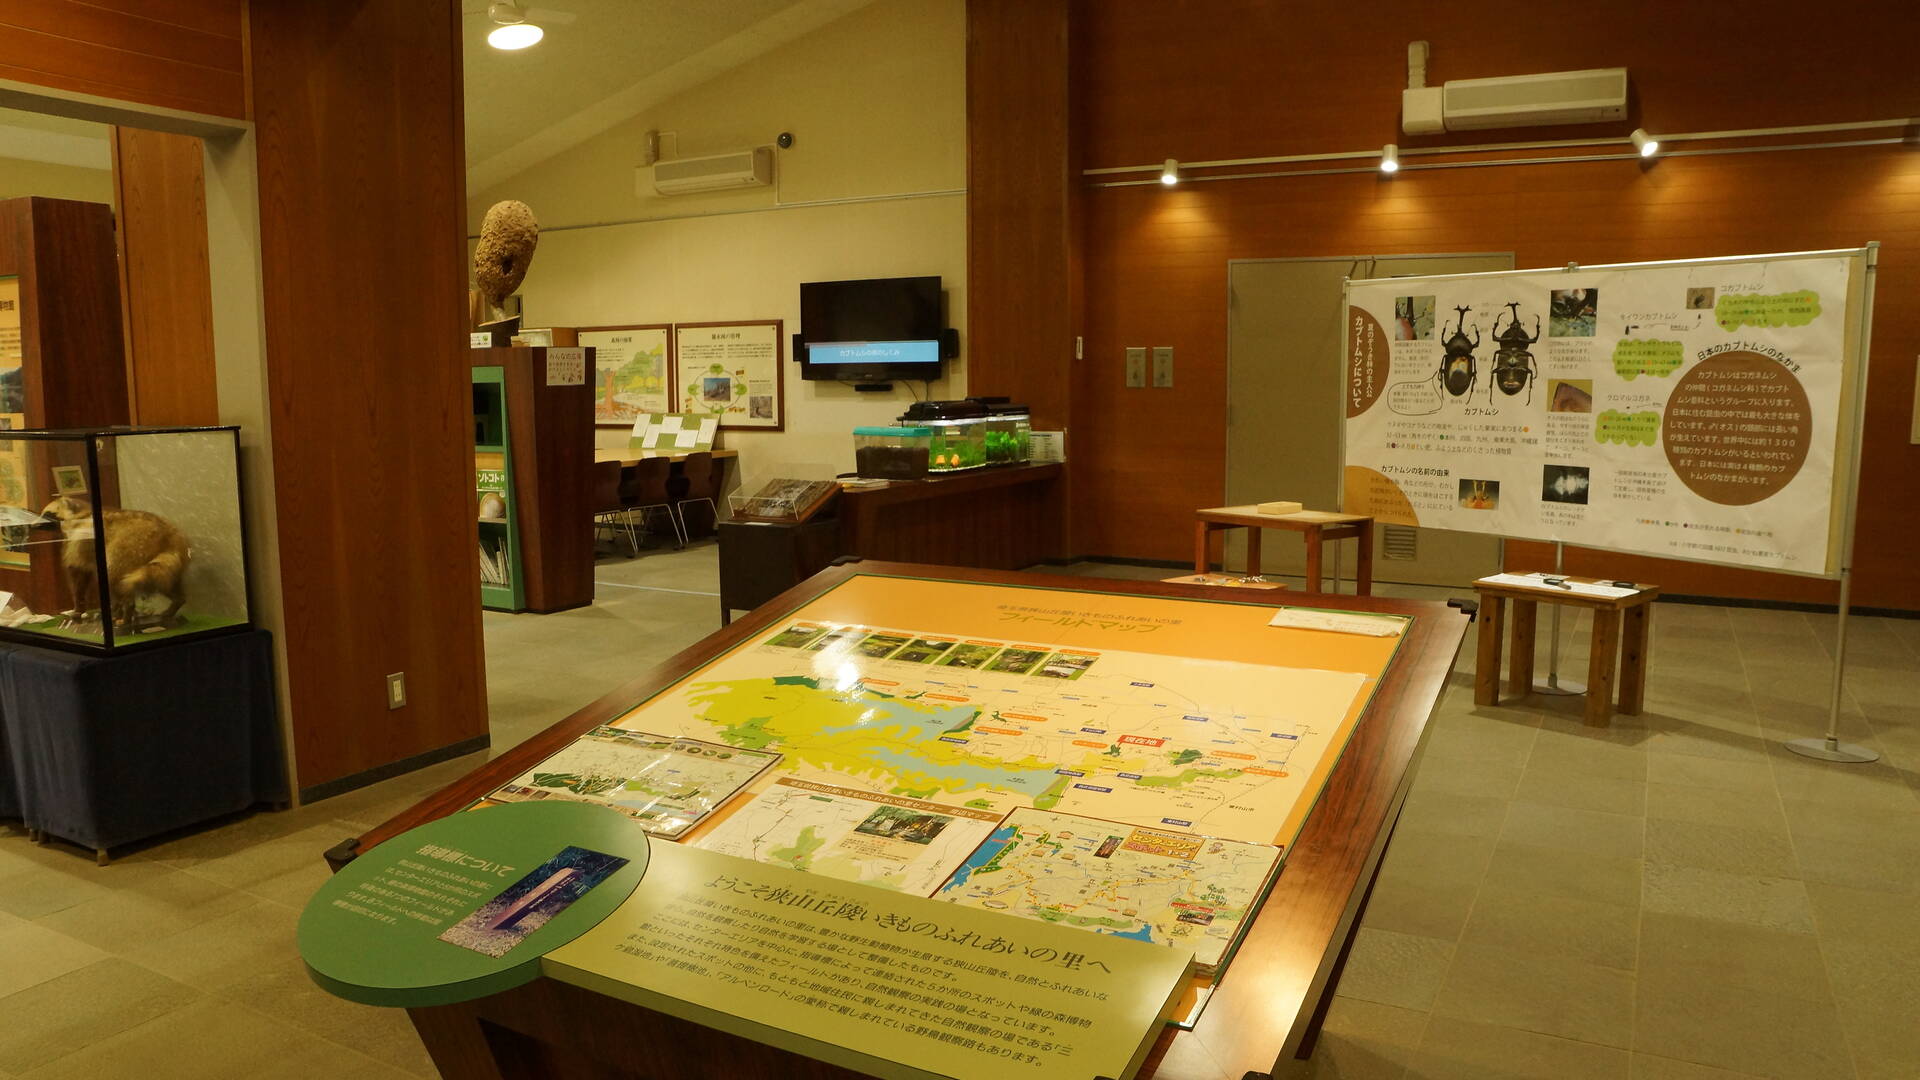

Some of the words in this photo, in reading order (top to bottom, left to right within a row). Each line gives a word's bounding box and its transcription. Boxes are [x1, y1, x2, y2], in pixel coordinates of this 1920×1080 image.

[1352, 315, 1363, 408] カブトムシについて
[1697, 341, 1802, 375] 日本のカブトムシのなかま
[1464, 407, 1500, 417] カブトムシ
[479, 473, 500, 484] ソトコト
[1381, 465, 1450, 477] カブトムシの名前の由来
[999, 612, 1163, 633] フィールドマップ
[704, 875, 1111, 974] ようこそ狭山丘陵いきものふれあいの里へ
